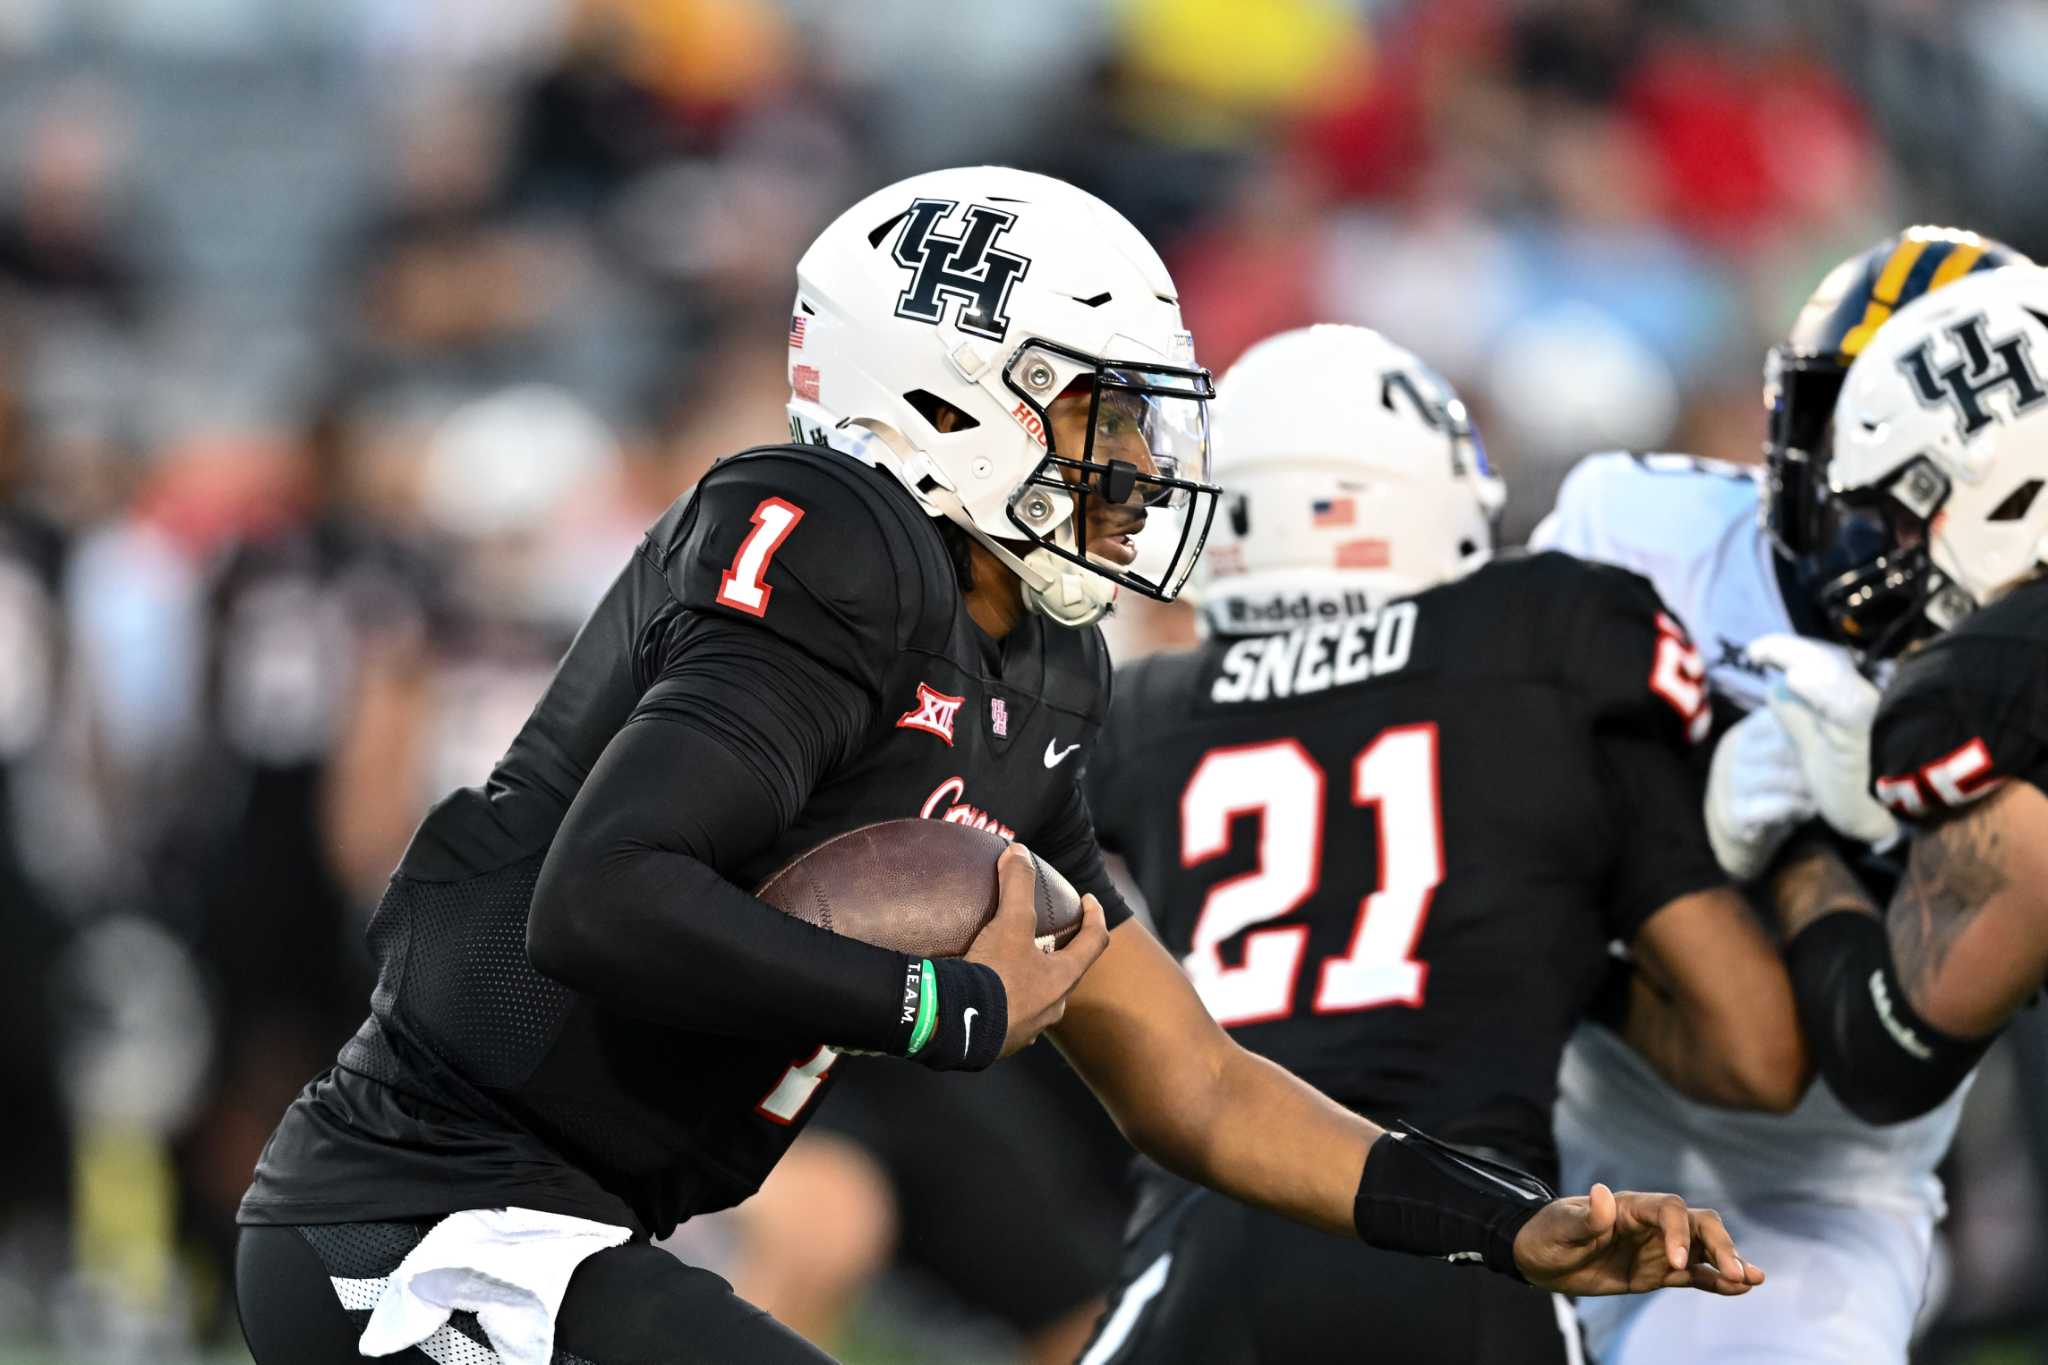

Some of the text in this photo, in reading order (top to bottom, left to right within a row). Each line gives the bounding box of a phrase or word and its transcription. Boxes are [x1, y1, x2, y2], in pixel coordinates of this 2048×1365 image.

[716, 496, 806, 618] 1
[1211, 601, 1419, 703] SNEED
[1180, 721, 1448, 1030] 21
[900, 963, 921, 1024] T.E.A.M.
